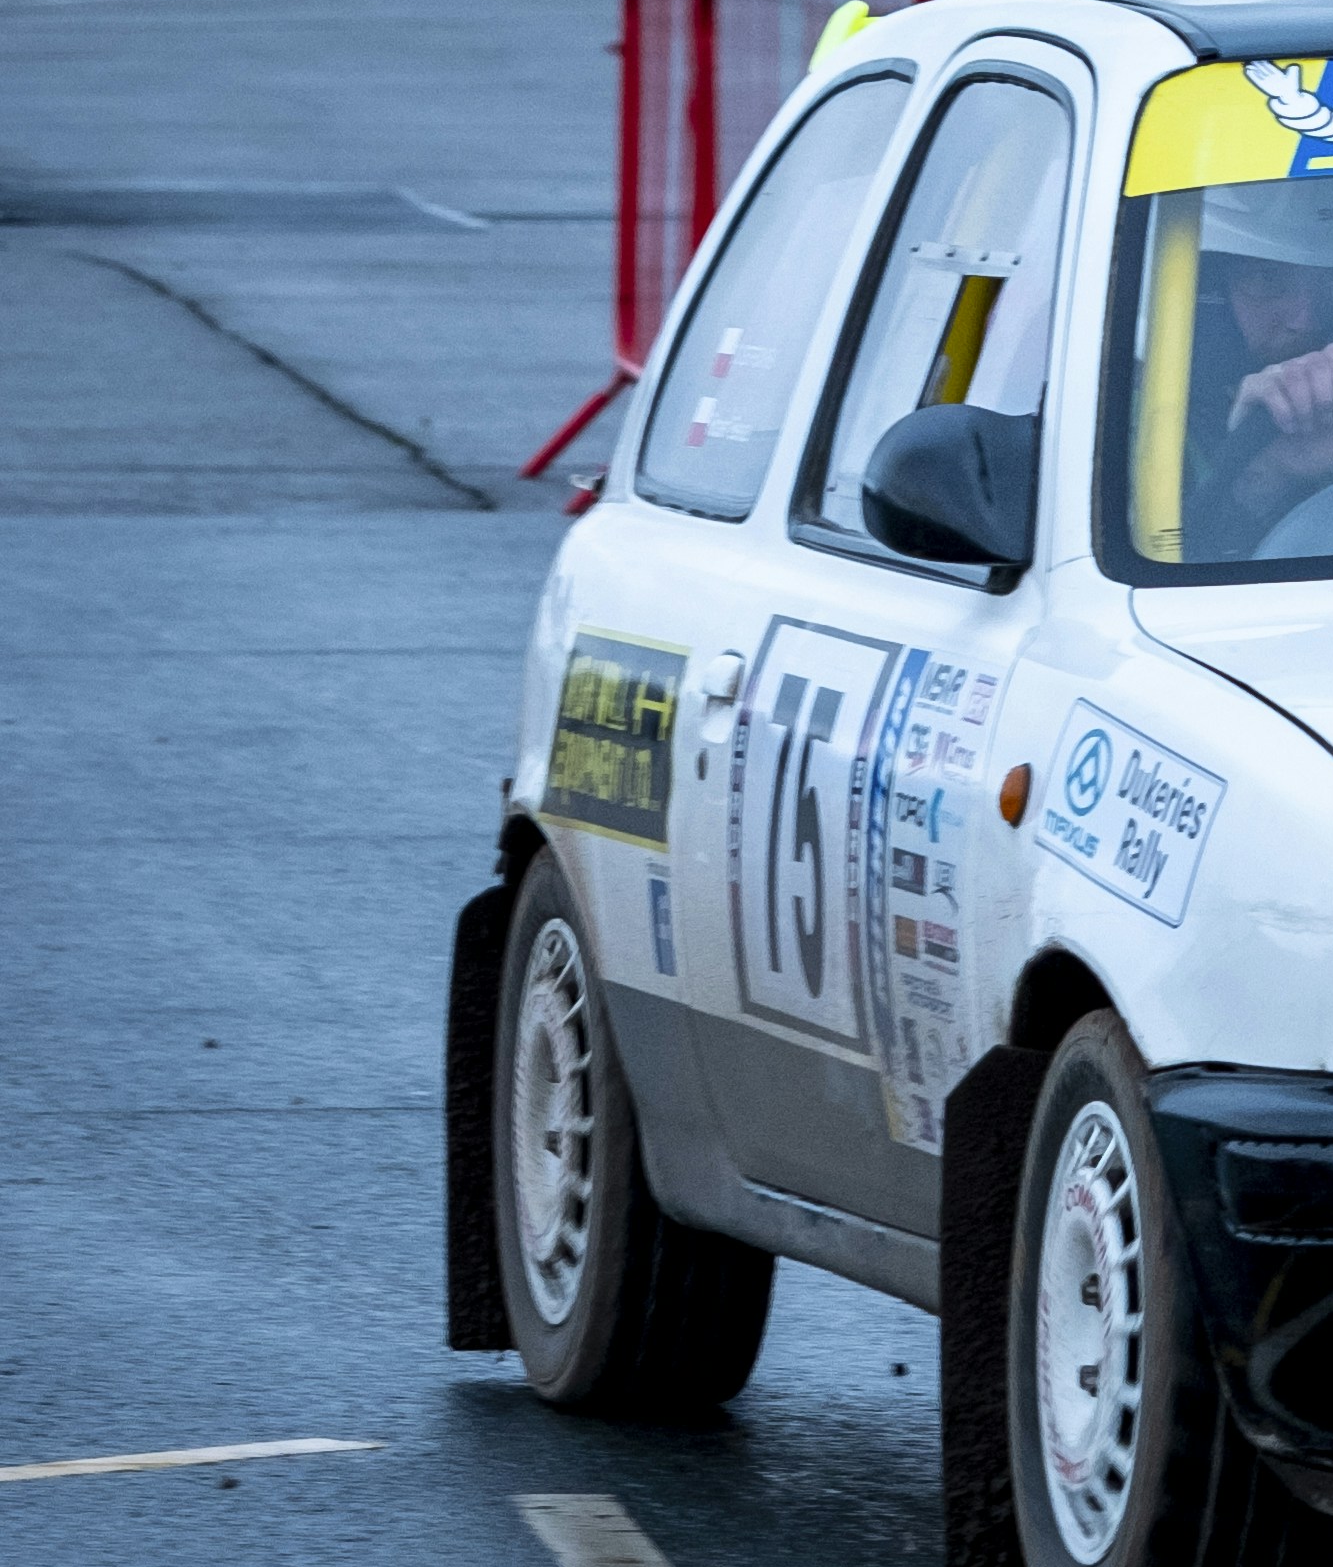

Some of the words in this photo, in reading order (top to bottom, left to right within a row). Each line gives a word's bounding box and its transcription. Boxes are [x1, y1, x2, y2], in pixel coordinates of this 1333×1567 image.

[767, 672, 846, 1000] 75
[1116, 748, 1208, 840] Dukeries
[1112, 817, 1170, 899] Rally
